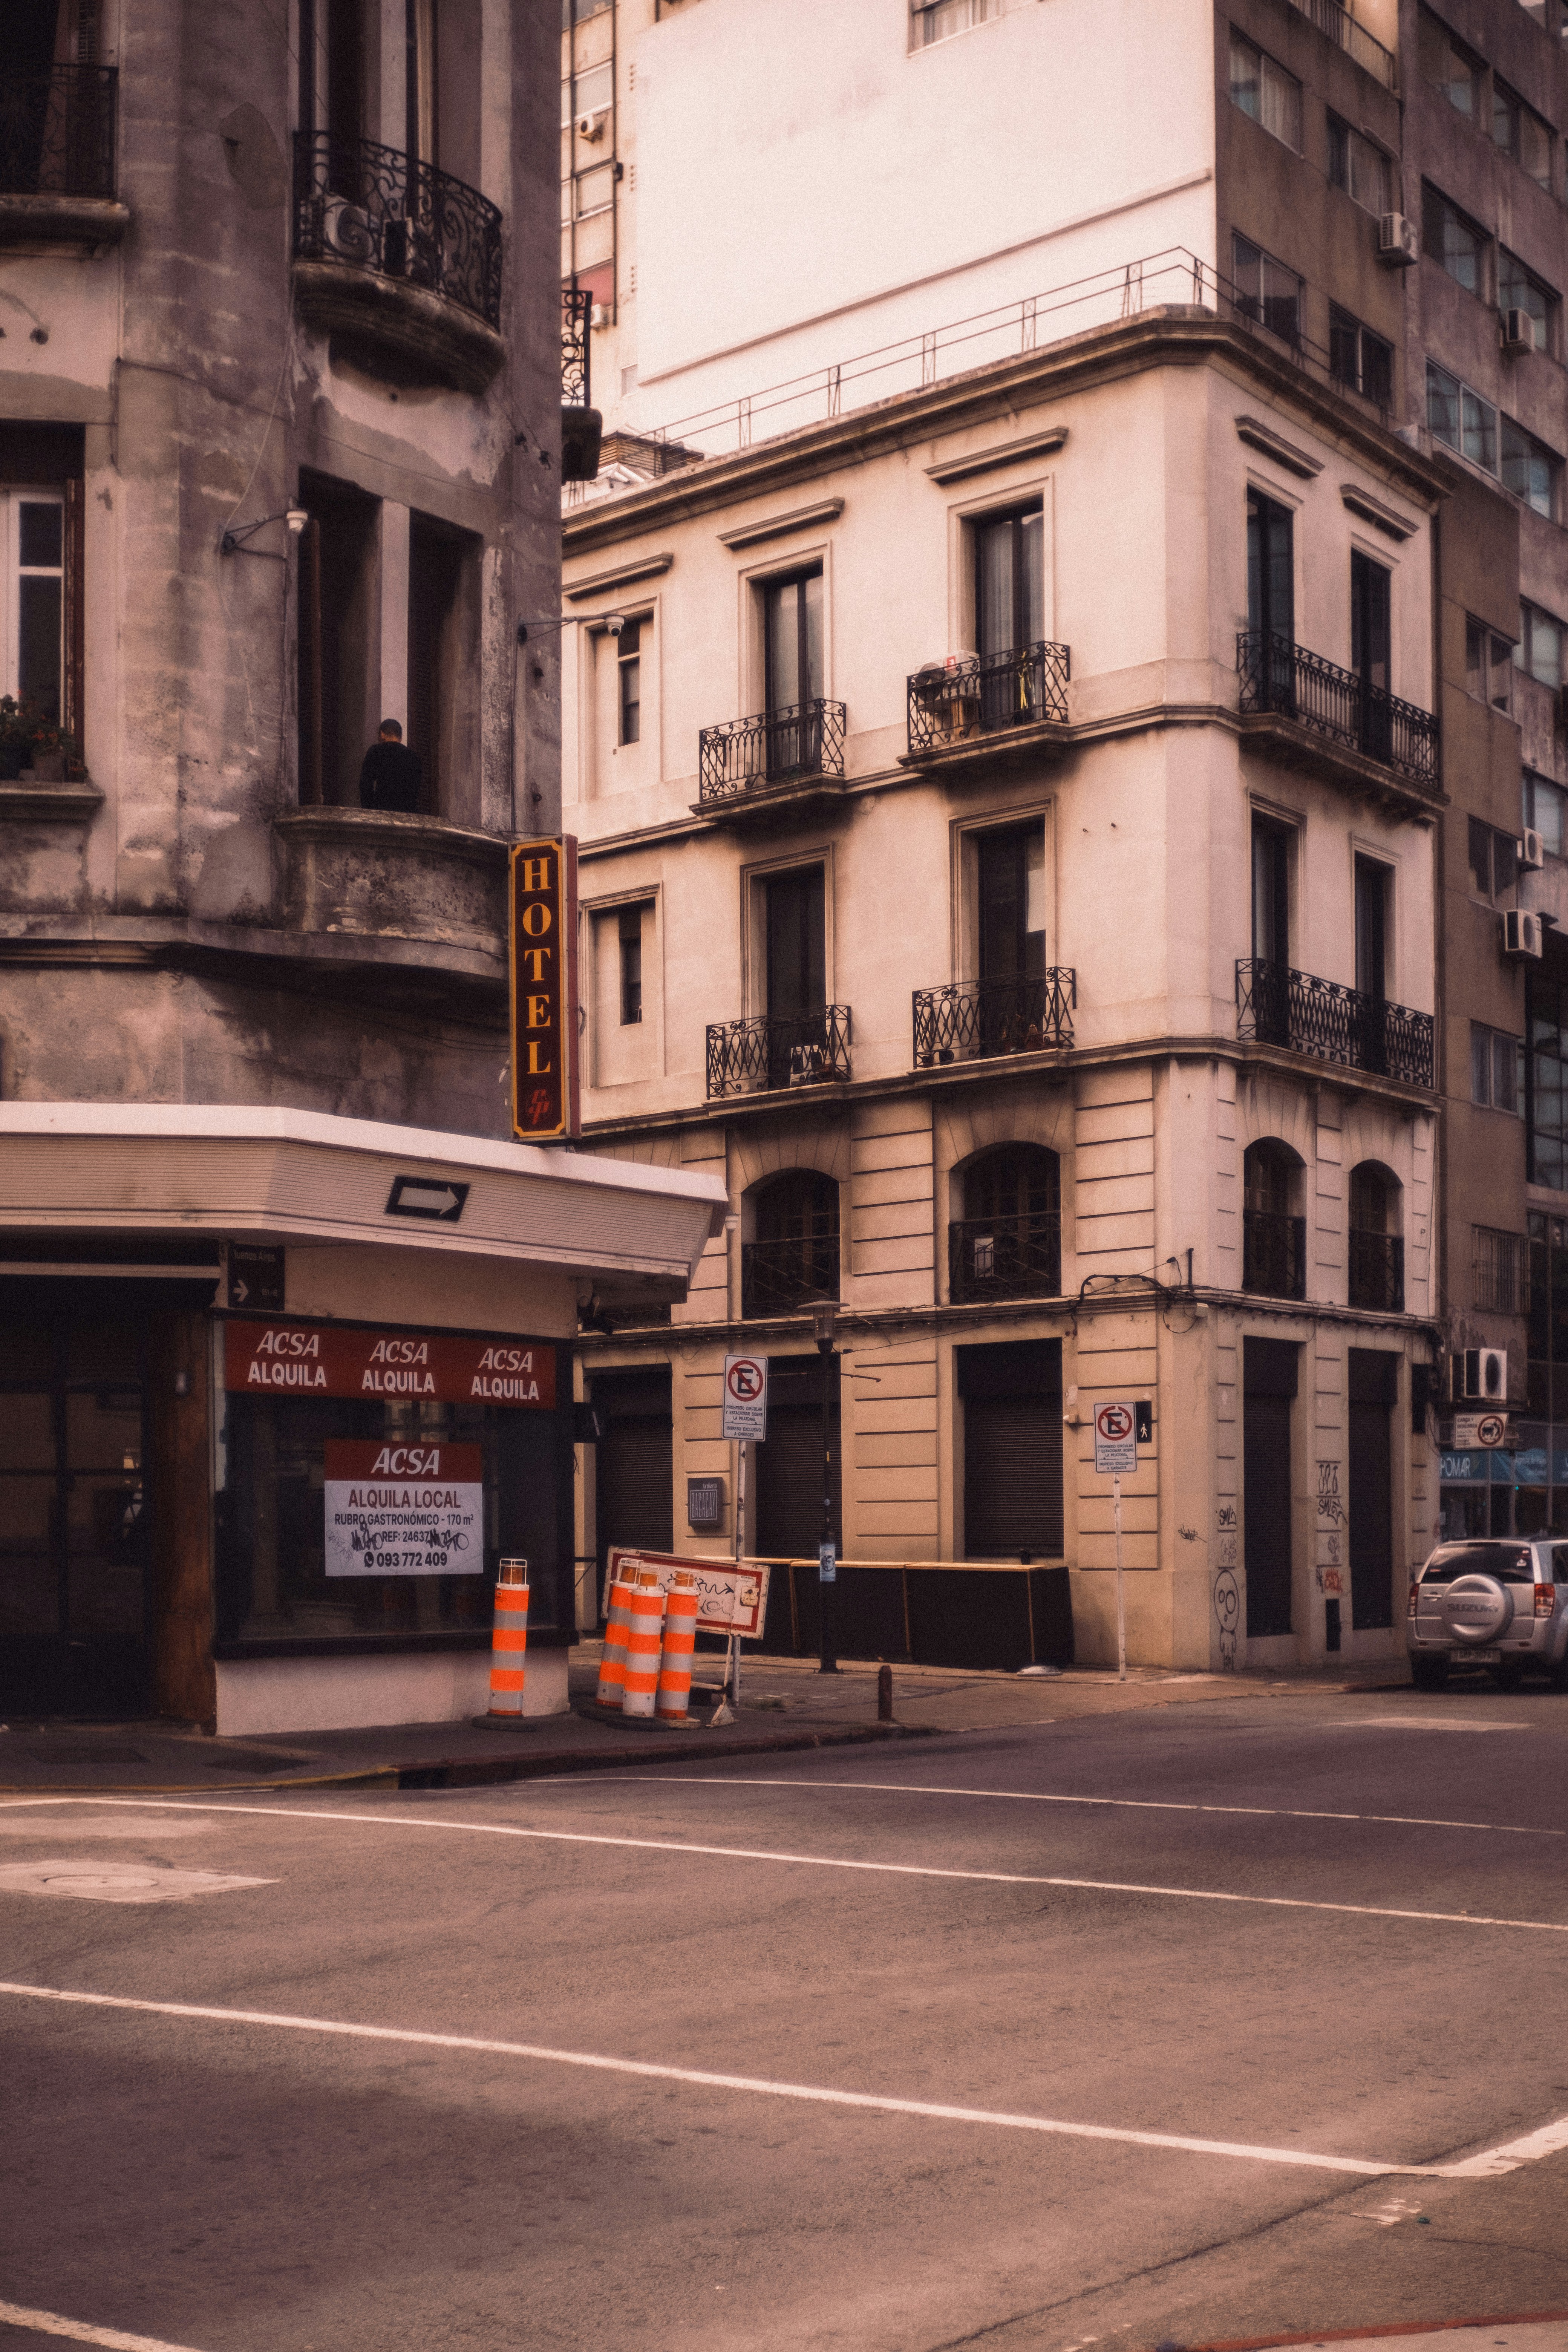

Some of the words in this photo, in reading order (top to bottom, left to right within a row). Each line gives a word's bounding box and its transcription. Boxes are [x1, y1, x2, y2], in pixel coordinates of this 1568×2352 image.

[522, 856, 552, 1074] HOTEL
[256, 1331, 319, 1357] ACSA
[369, 1340, 427, 1364] ACSA
[478, 1348, 532, 1373] ACSA
[247, 1361, 327, 1387] ALQUILA
[361, 1369, 435, 1393] ALQUILA
[471, 1376, 539, 1400] ALQUILA
[371, 1448, 439, 1475] ACSA
[348, 1489, 411, 1509] ALQUILA
[415, 1490, 461, 1508] LOCAL
[335, 1514, 365, 1525] RUBRO
[368, 1511, 439, 1525] GASTRONÓMICO
[447, 1514, 461, 1525] 170
[382, 1531, 400, 1542] REF:
[403, 1531, 430, 1542] 24637
[377, 1553, 400, 1567] 093
[402, 1553, 422, 1566] 772
[425, 1552, 447, 1566] 409
[1447, 1604, 1499, 1612] SUZUKI
